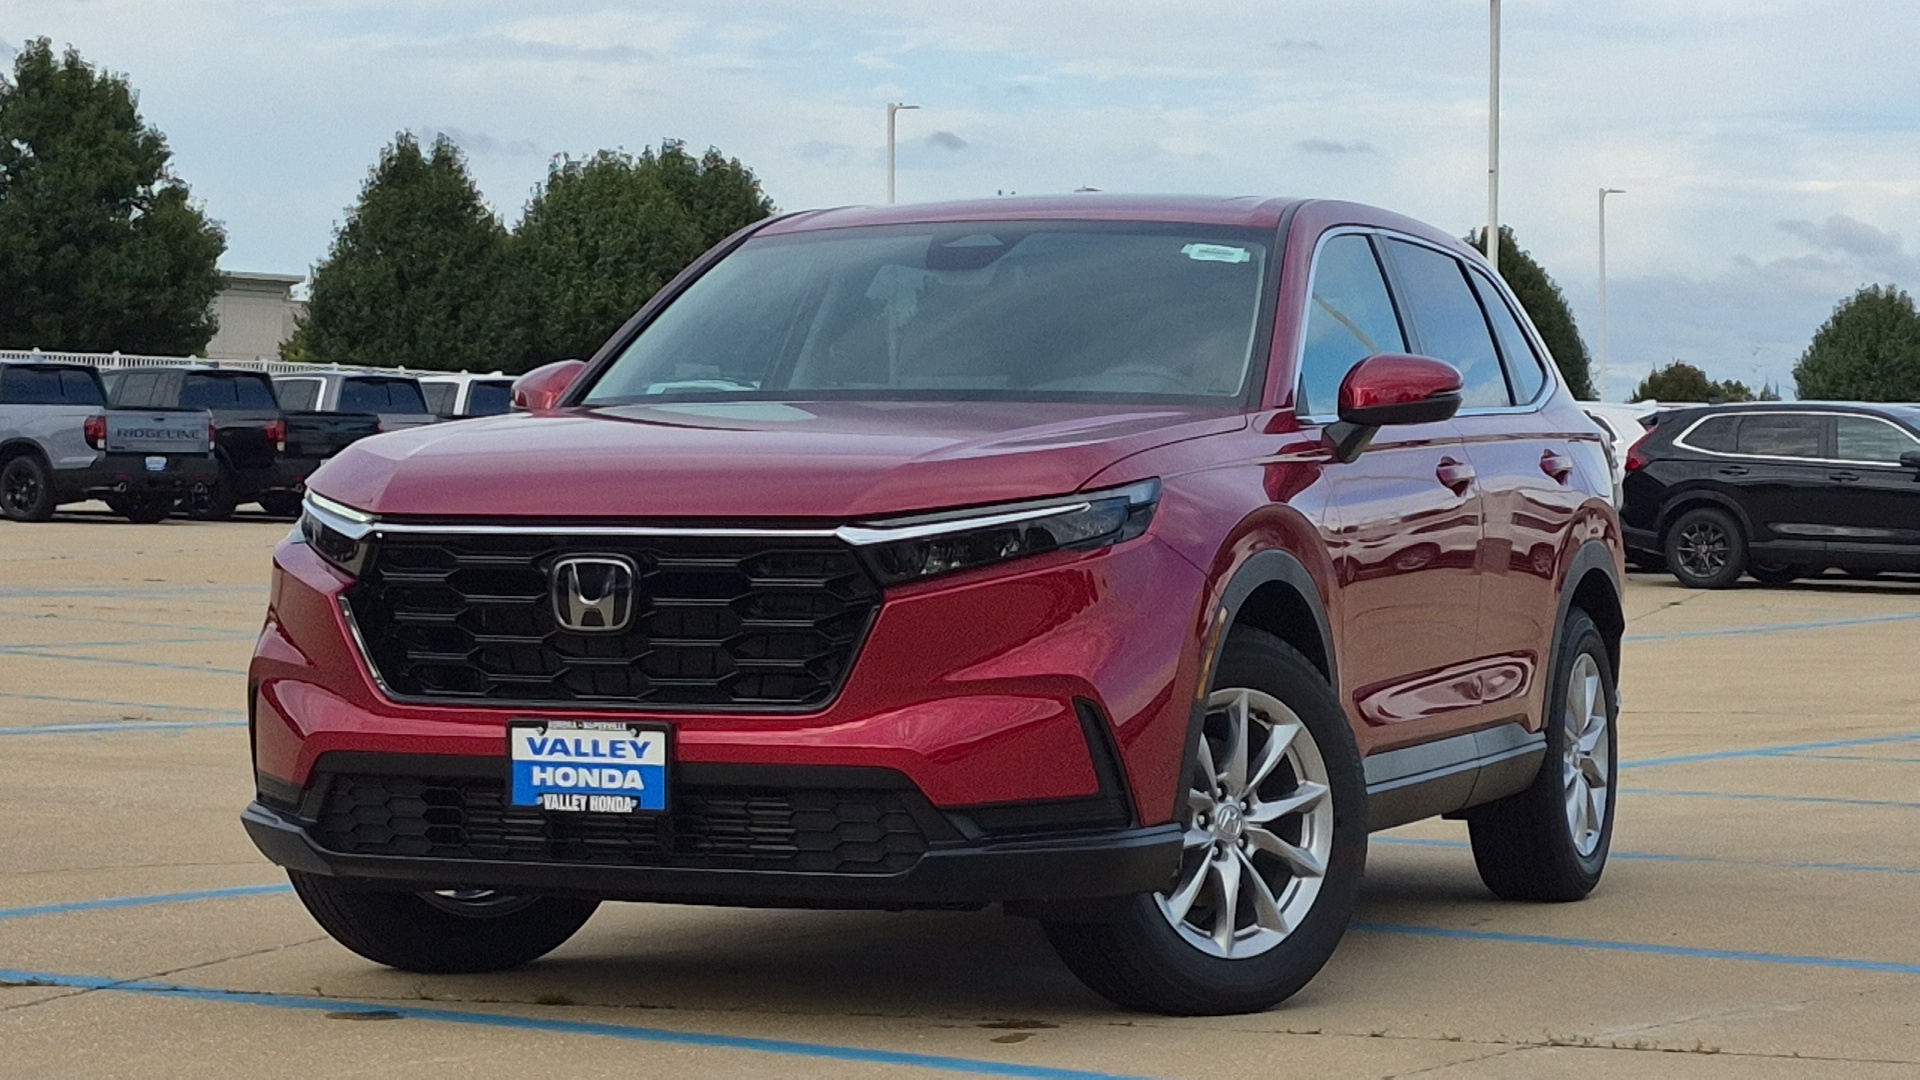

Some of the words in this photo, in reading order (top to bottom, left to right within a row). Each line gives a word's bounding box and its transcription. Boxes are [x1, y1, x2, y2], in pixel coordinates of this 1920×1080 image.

[117, 428, 201, 439] RIDGELINE
[527, 737, 650, 758] VALLEY
[532, 766, 644, 790] HONDA
[544, 794, 587, 811] VALLEY
[589, 795, 632, 813] HONDA
